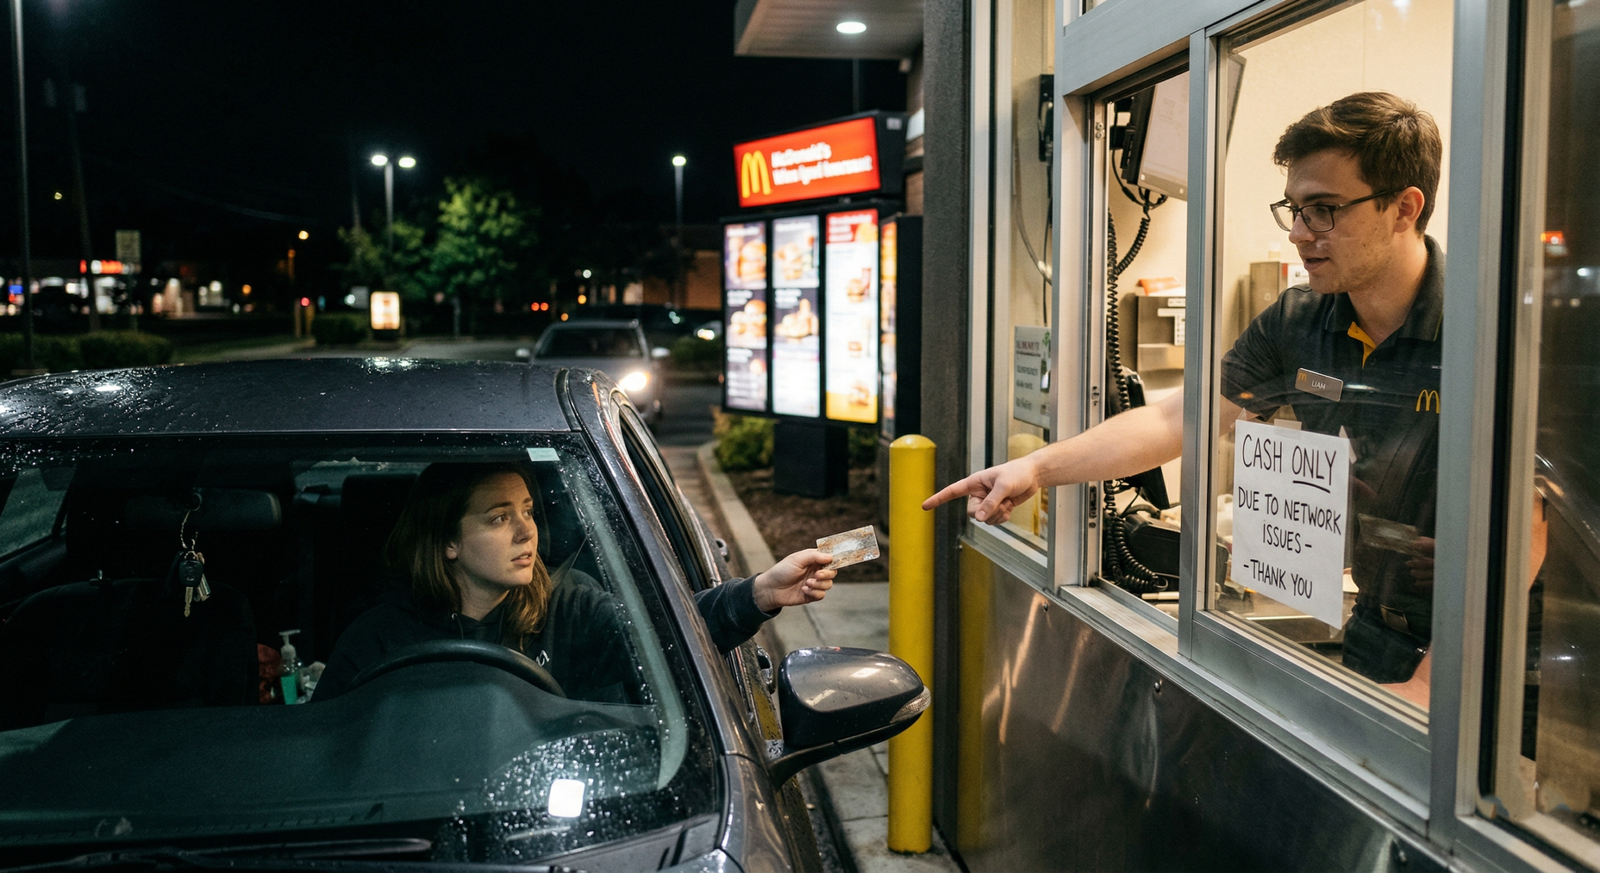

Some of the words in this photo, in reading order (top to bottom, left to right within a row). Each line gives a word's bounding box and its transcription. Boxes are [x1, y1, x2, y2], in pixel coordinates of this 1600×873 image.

[1311, 379, 1327, 390] LIAM
[1242, 434, 1283, 474] CASH
[1292, 445, 1337, 486] ONLY
[1238, 486, 1260, 511] DUE
[1264, 493, 1279, 516] TO
[1283, 499, 1342, 536] NETWORK
[1291, 573, 1313, 599] YOU
